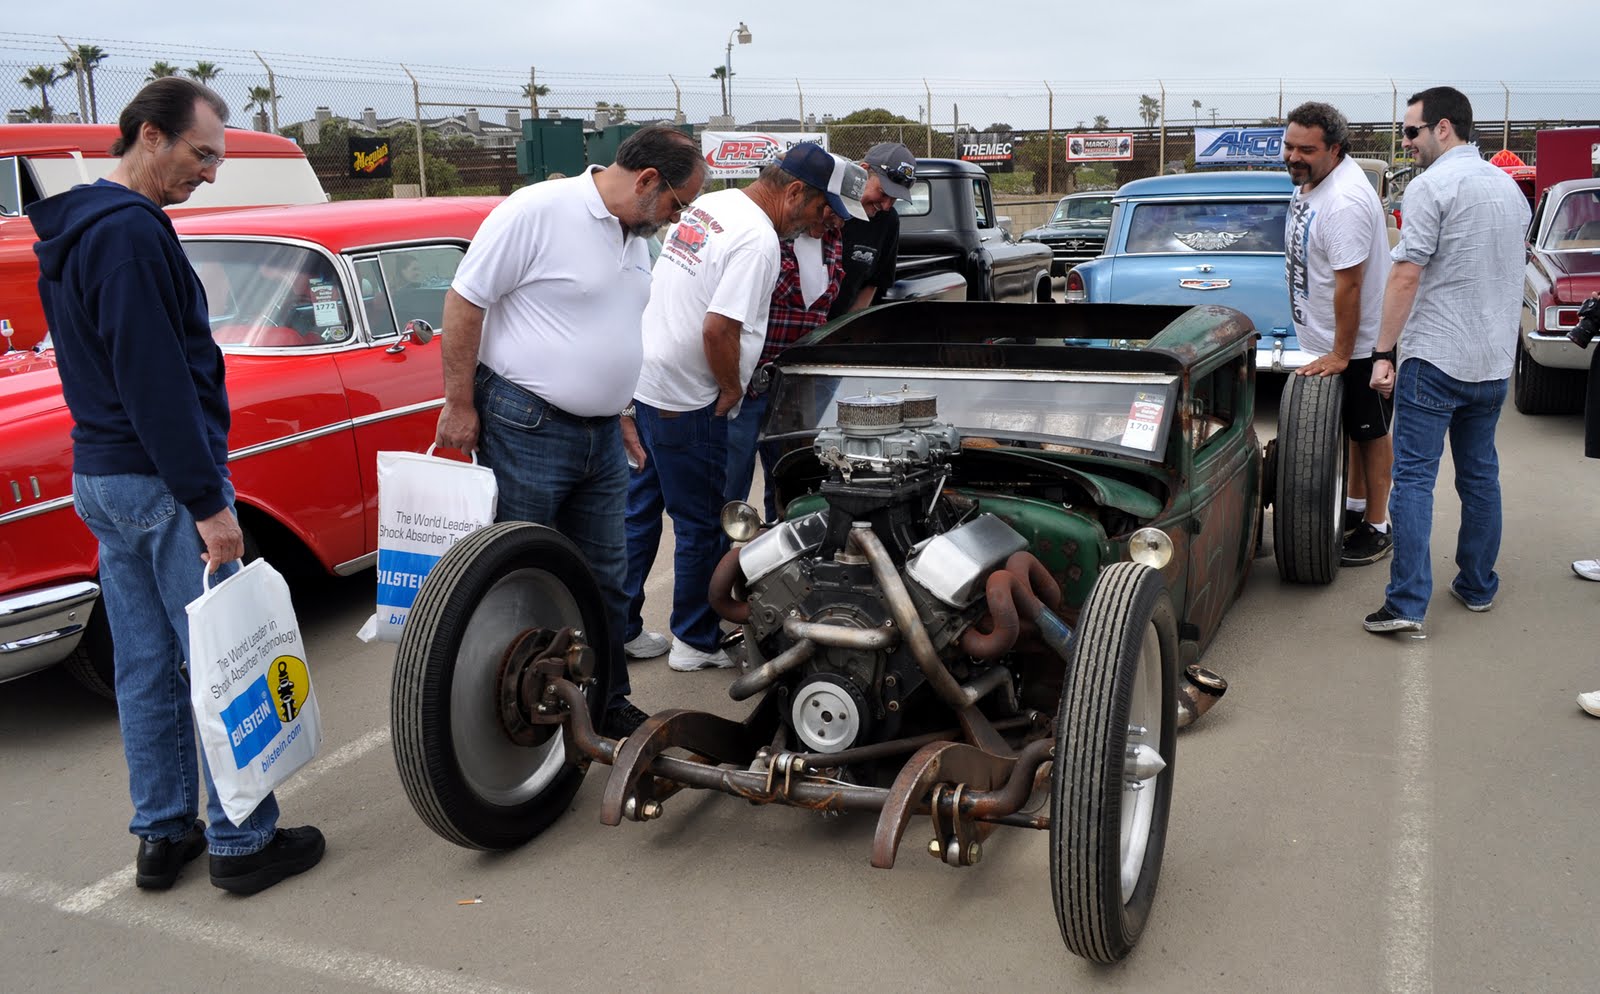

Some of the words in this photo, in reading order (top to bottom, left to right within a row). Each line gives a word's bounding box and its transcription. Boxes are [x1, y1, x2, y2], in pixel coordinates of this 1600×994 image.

[718, 140, 767, 160] PRC
[963, 143, 1012, 156] TREMEC
[1199, 130, 1284, 156] AFCO
[1130, 422, 1155, 431] 1704
[396, 511, 412, 525] The
[414, 513, 442, 528] World
[443, 517, 473, 532] Leader
[380, 524, 404, 539] Shock
[405, 529, 447, 544] Absorber
[377, 570, 428, 589] BILSTEI
[228, 640, 250, 663] World
[249, 626, 267, 647] Leader
[268, 619, 278, 632] in
[231, 655, 259, 684] Absorber
[257, 628, 297, 659] Technology
[231, 699, 272, 748] BILSTEIN
[261, 723, 302, 773] bilstein.com
